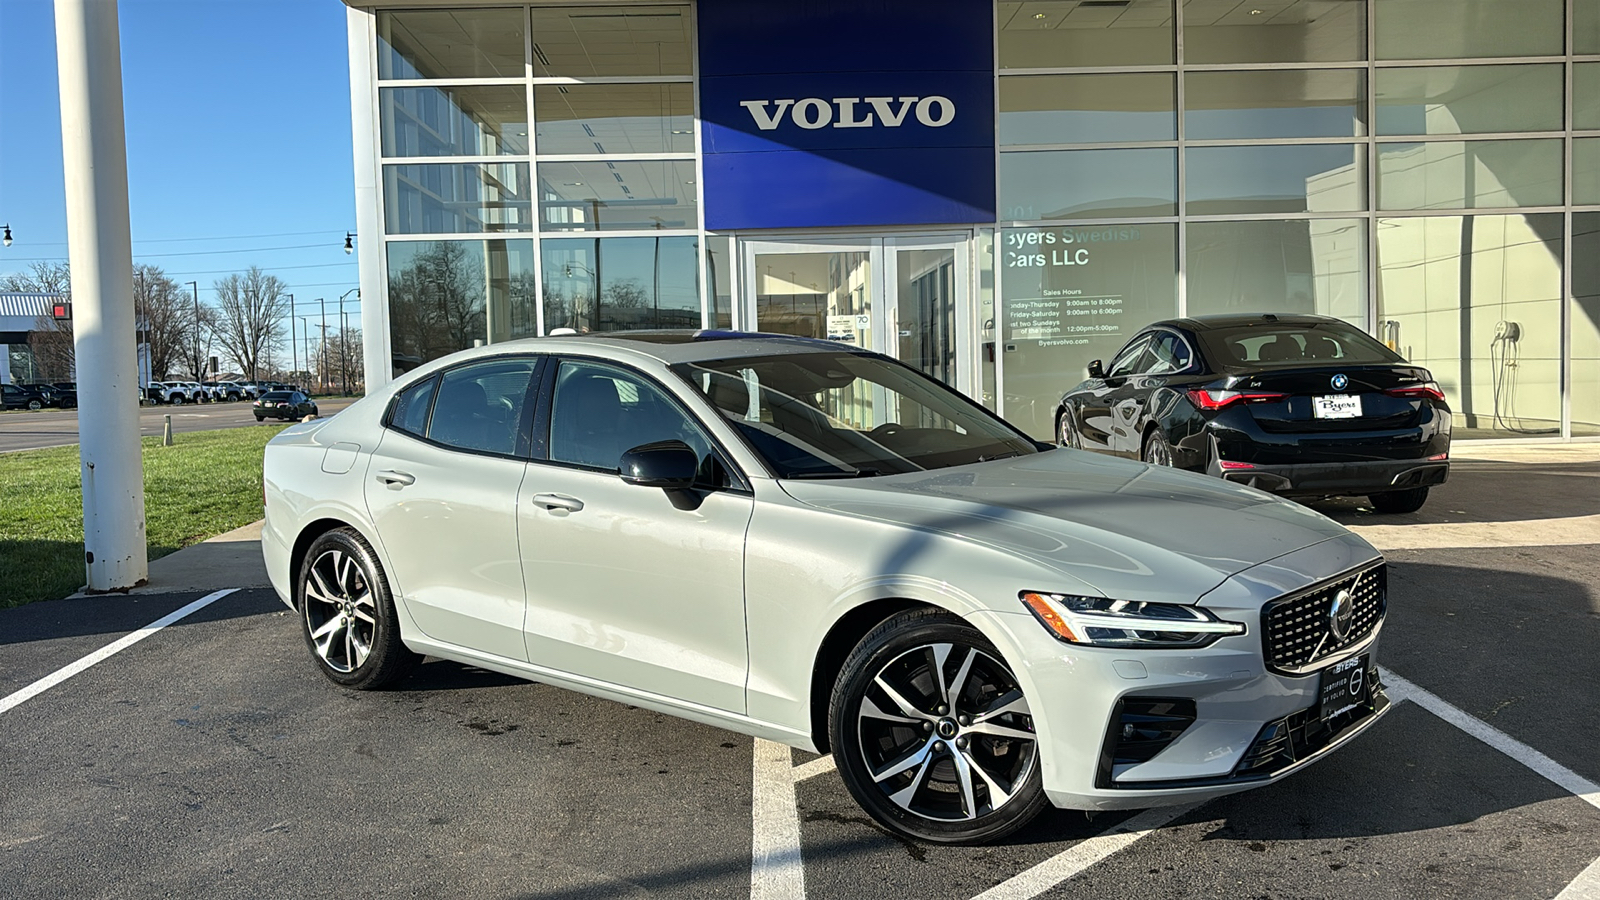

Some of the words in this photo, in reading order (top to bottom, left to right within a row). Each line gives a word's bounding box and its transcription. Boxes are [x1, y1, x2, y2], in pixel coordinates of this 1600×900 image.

[740, 95, 955, 130] VOLVO
[1004, 230, 1056, 249] Byers
[1062, 228, 1140, 243] Swedish
[1004, 251, 1046, 267] Cars
[1052, 249, 1089, 266] LLC
[1010, 302, 1060, 310] onday-Thursday
[857, 315, 869, 324] 70
[1010, 311, 1060, 319] Friday-Saturday
[1032, 319, 1061, 327] Sundays
[1038, 338, 1089, 347] Byersvolvo.com
[1318, 399, 1356, 412] Byers
[1323, 678, 1347, 693] CERTIFIED
[1330, 689, 1345, 700] VOLVO
